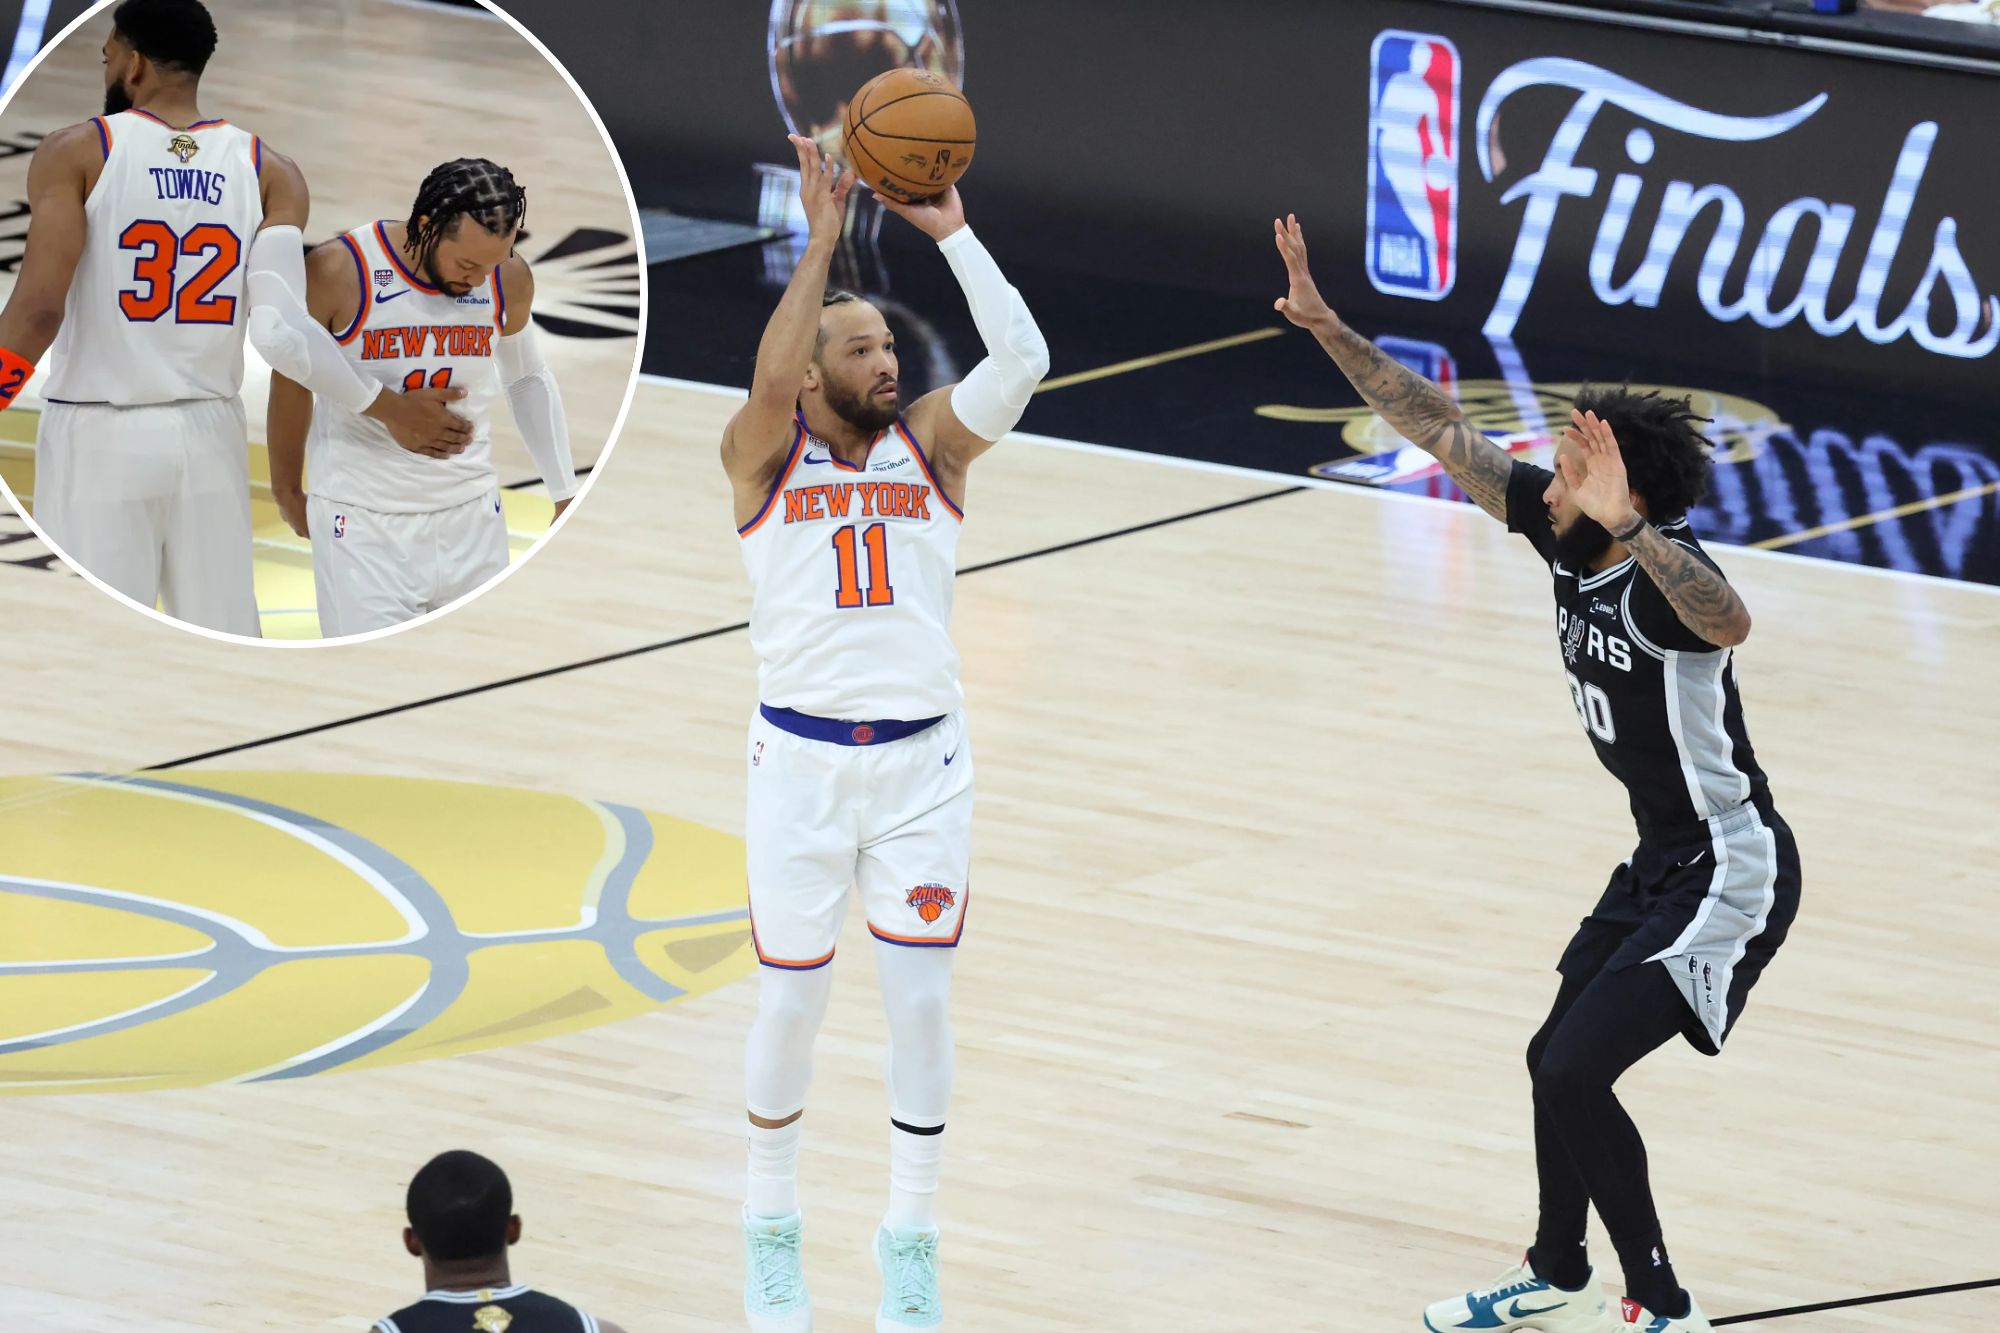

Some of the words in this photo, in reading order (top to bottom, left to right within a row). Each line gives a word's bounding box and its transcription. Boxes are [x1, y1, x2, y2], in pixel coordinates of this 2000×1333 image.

[149, 168, 225, 206] TOWNS
[1476, 57, 2000, 358] Finals
[118, 219, 242, 325] 32
[361, 326, 429, 360] NEW
[431, 325, 493, 357] YORK
[887, 456, 911, 470] dhabi
[784, 483, 853, 524] NEW
[857, 482, 930, 520] YORK
[832, 523, 894, 609] 11
[1565, 668, 1617, 745] 30
[906, 885, 955, 906] KNICKS
